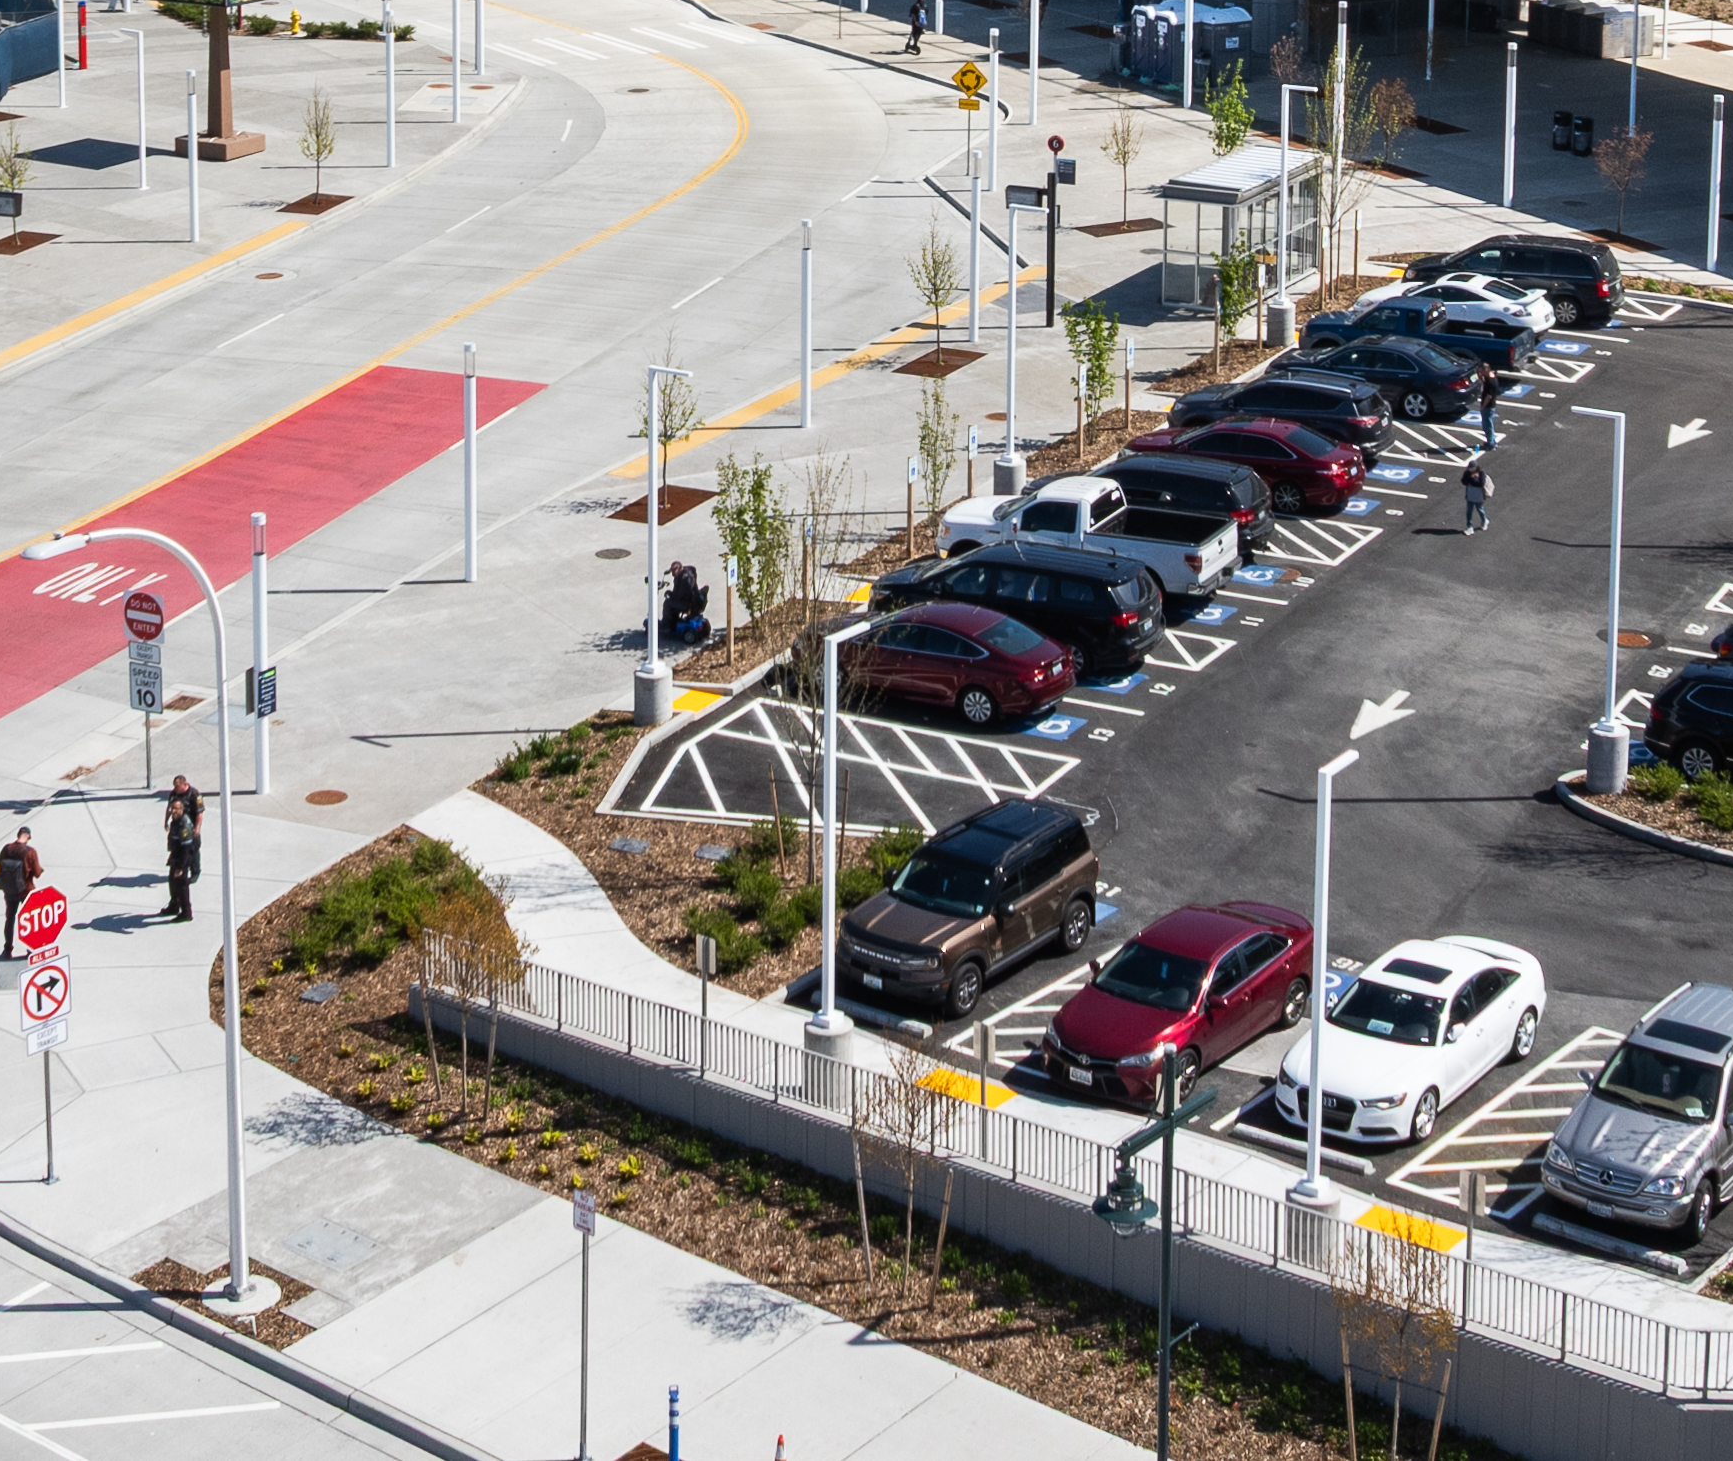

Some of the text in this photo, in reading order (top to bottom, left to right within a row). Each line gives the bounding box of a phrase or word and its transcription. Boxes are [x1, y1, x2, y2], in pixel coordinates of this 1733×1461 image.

[1052, 139, 1059, 148] 6
[33, 562, 168, 606] ONLY
[130, 599, 156, 611] DO NOT
[133, 622, 155, 635] ENTER
[132, 667, 159, 680] SPEED
[135, 677, 156, 689] LIMIT
[1148, 683, 1176, 696] 12
[137, 688, 155, 708] 10
[1087, 728, 1115, 742] 13
[19, 900, 65, 937] STOP
[31, 948, 57, 963] ALL WAY
[1331, 957, 1364, 971] 16
